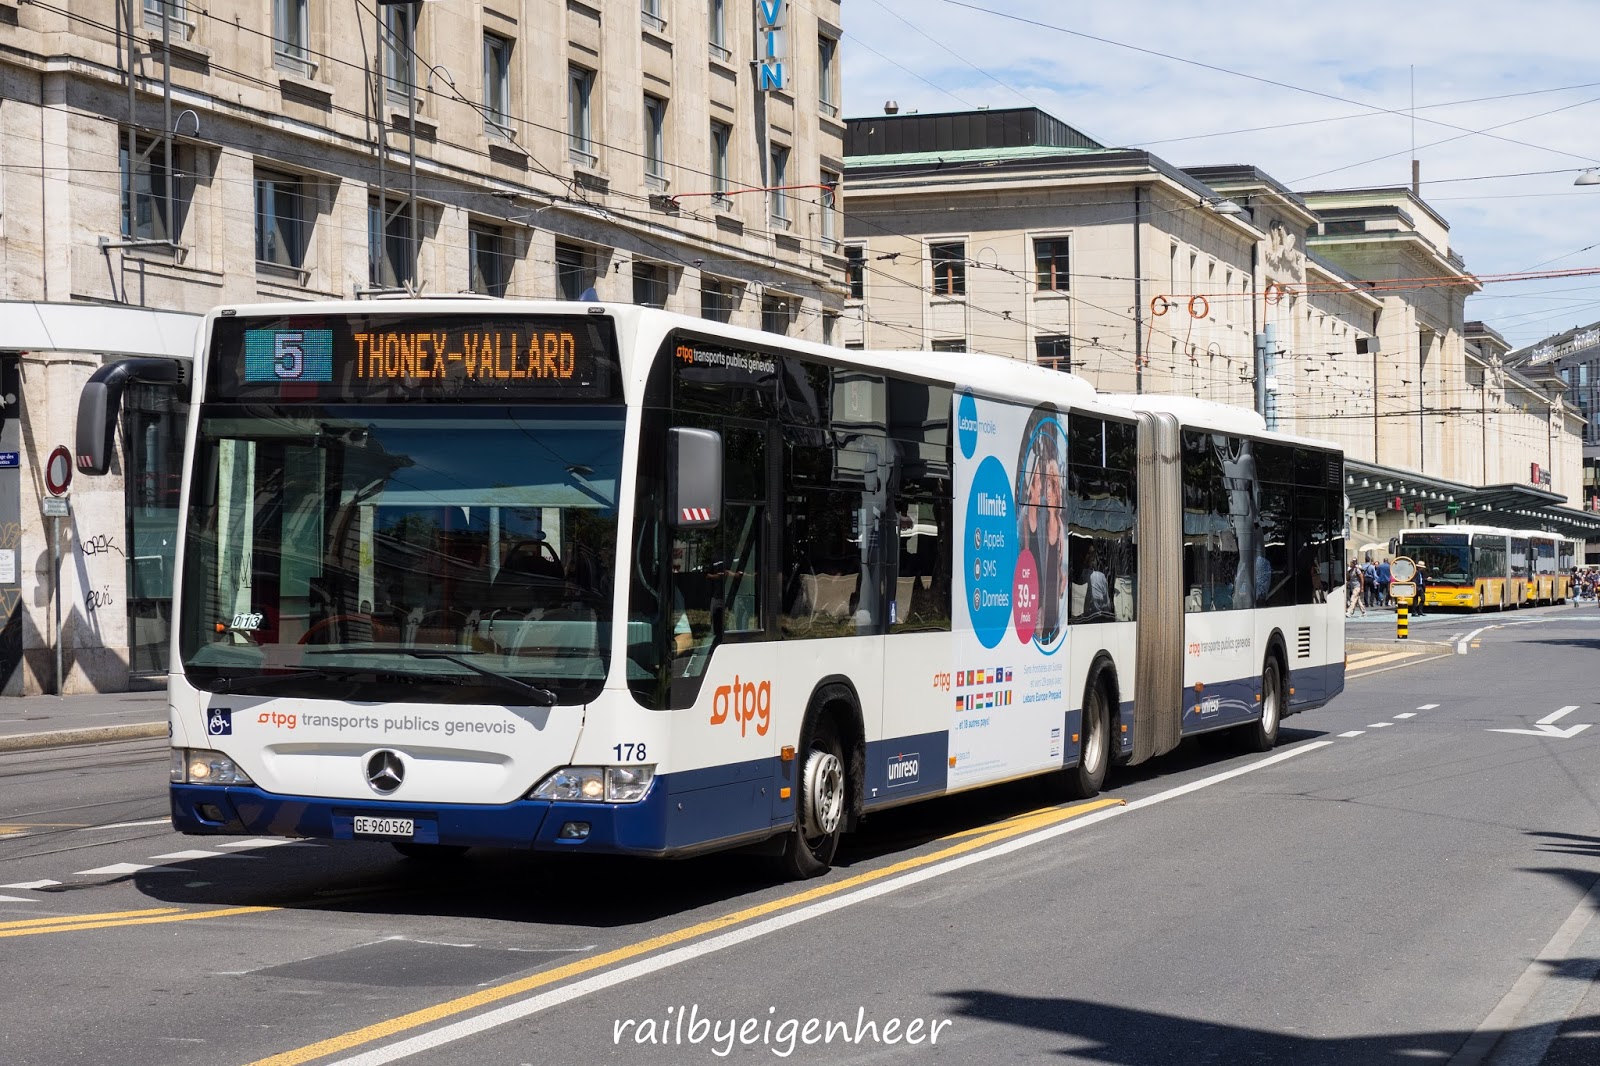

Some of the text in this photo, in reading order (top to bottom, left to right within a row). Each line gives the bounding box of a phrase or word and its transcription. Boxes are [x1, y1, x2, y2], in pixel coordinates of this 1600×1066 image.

[273, 333, 575, 378] 5 THONEX-VALLARD
[693, 348, 725, 367] transports
[725, 352, 748, 370] publics
[748, 358, 775, 374] genevois
[958, 415, 997, 435] Lebara mobile
[977, 492, 1007, 518] Illimité
[983, 529, 1005, 551] Appels
[982, 560, 997, 578] SMS
[1022, 568, 1031, 579] CHF
[982, 589, 1009, 608] Données
[232, 615, 260, 628] 013
[1201, 641, 1220, 655] transports
[1221, 636, 1234, 653] publics
[1235, 638, 1251, 653] genevois
[1201, 699, 1219, 714] unireso
[302, 712, 379, 731] transports
[384, 714, 440, 733] publics
[445, 719, 516, 736] genevois
[613, 743, 647, 761] 178
[888, 759, 918, 780] unireso
